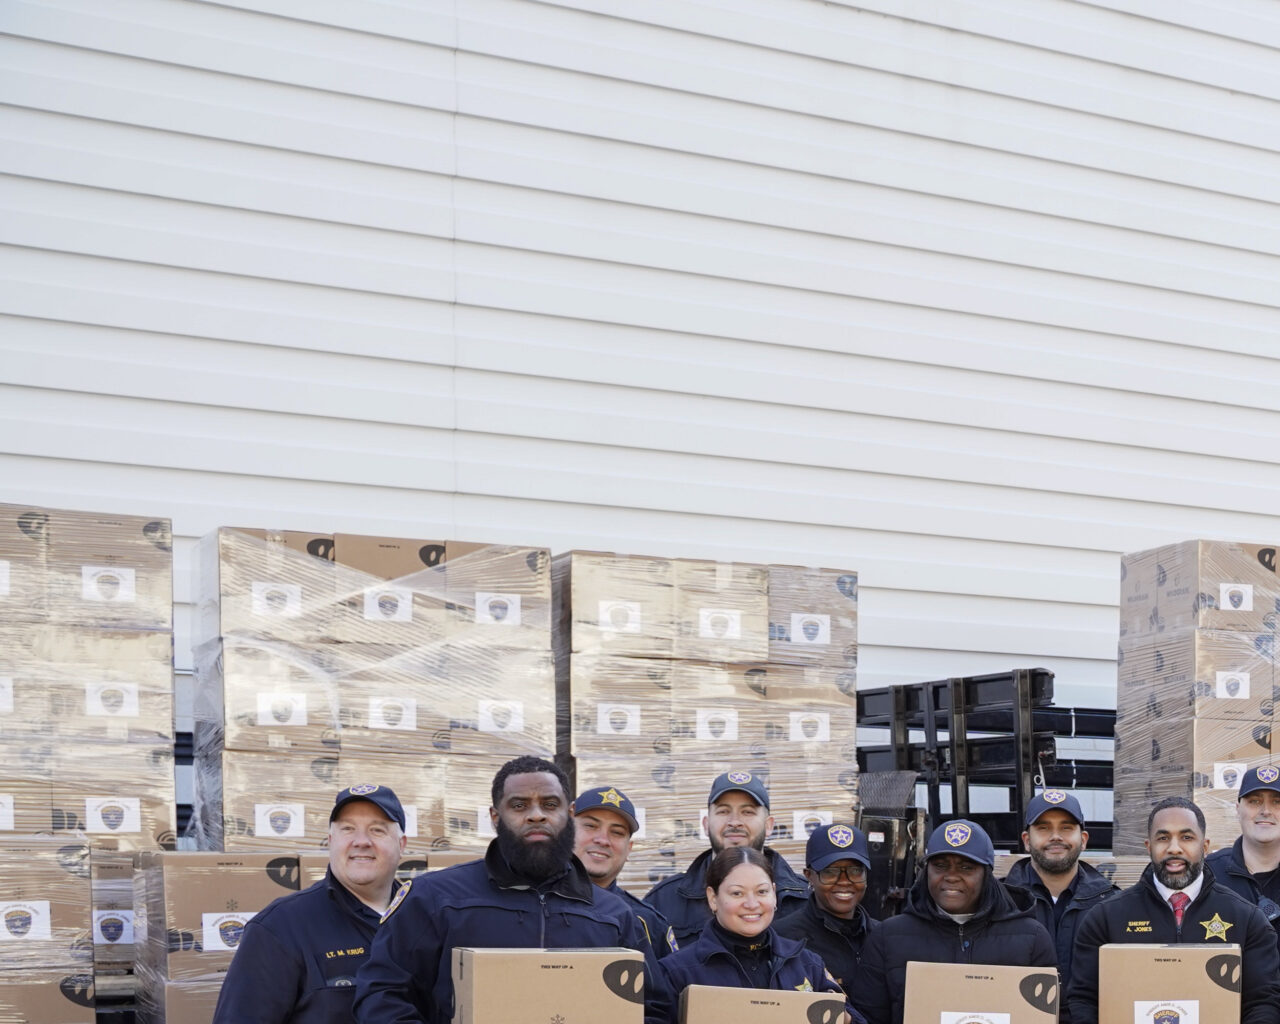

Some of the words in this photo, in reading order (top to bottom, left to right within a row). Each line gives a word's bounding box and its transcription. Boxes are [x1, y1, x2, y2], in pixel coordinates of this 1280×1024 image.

[326, 951, 336, 959] LT.
[346, 947, 365, 955] KRUG
[1146, 1004, 1160, 1016] SHERIFF
[1176, 1005, 1188, 1016] JONES
[1154, 1010, 1179, 1020] SHERIFF
